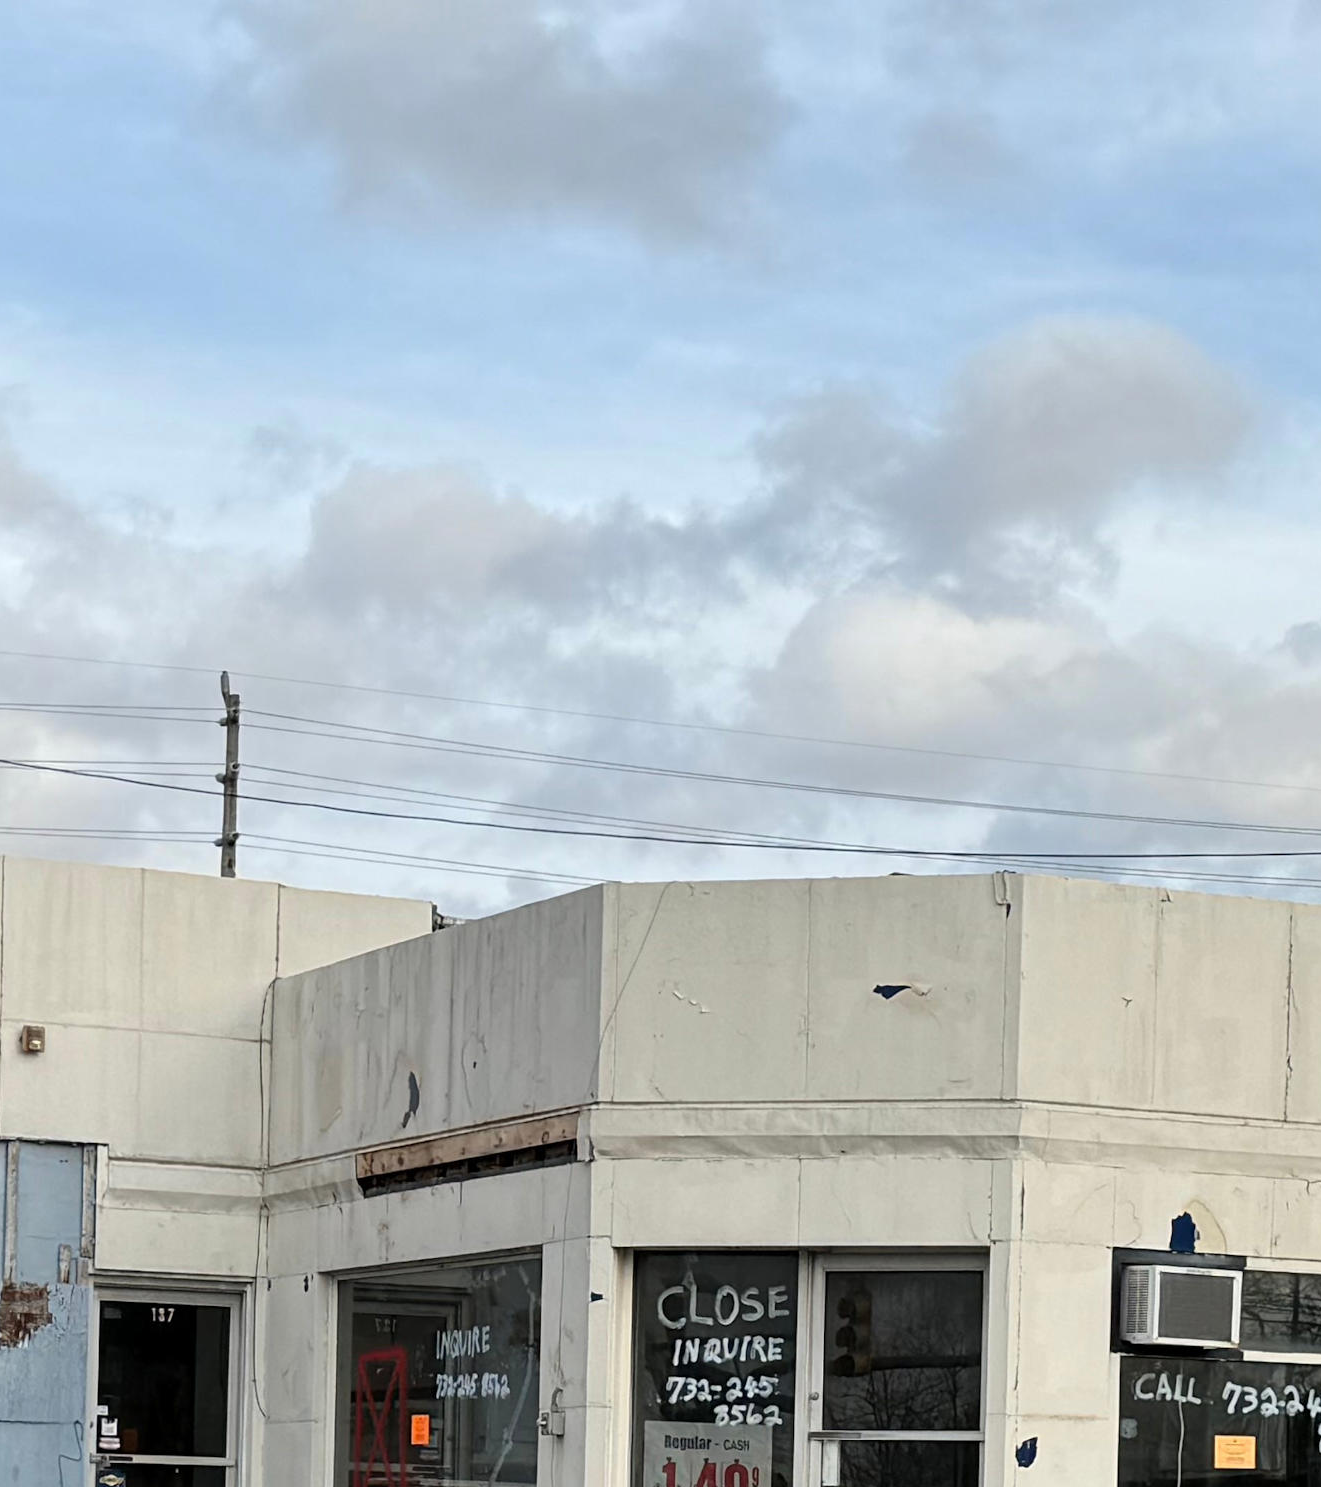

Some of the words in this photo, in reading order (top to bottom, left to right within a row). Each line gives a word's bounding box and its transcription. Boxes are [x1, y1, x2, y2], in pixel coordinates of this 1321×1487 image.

[657, 1284, 790, 1329] CLOSE
[436, 1325, 490, 1360] INQUIRE
[672, 1335, 785, 1366] INQUIRE
[1133, 1373, 1202, 1405] CALL
[663, 1435, 712, 1451] Regular
[723, 1439, 750, 1451] CASH
